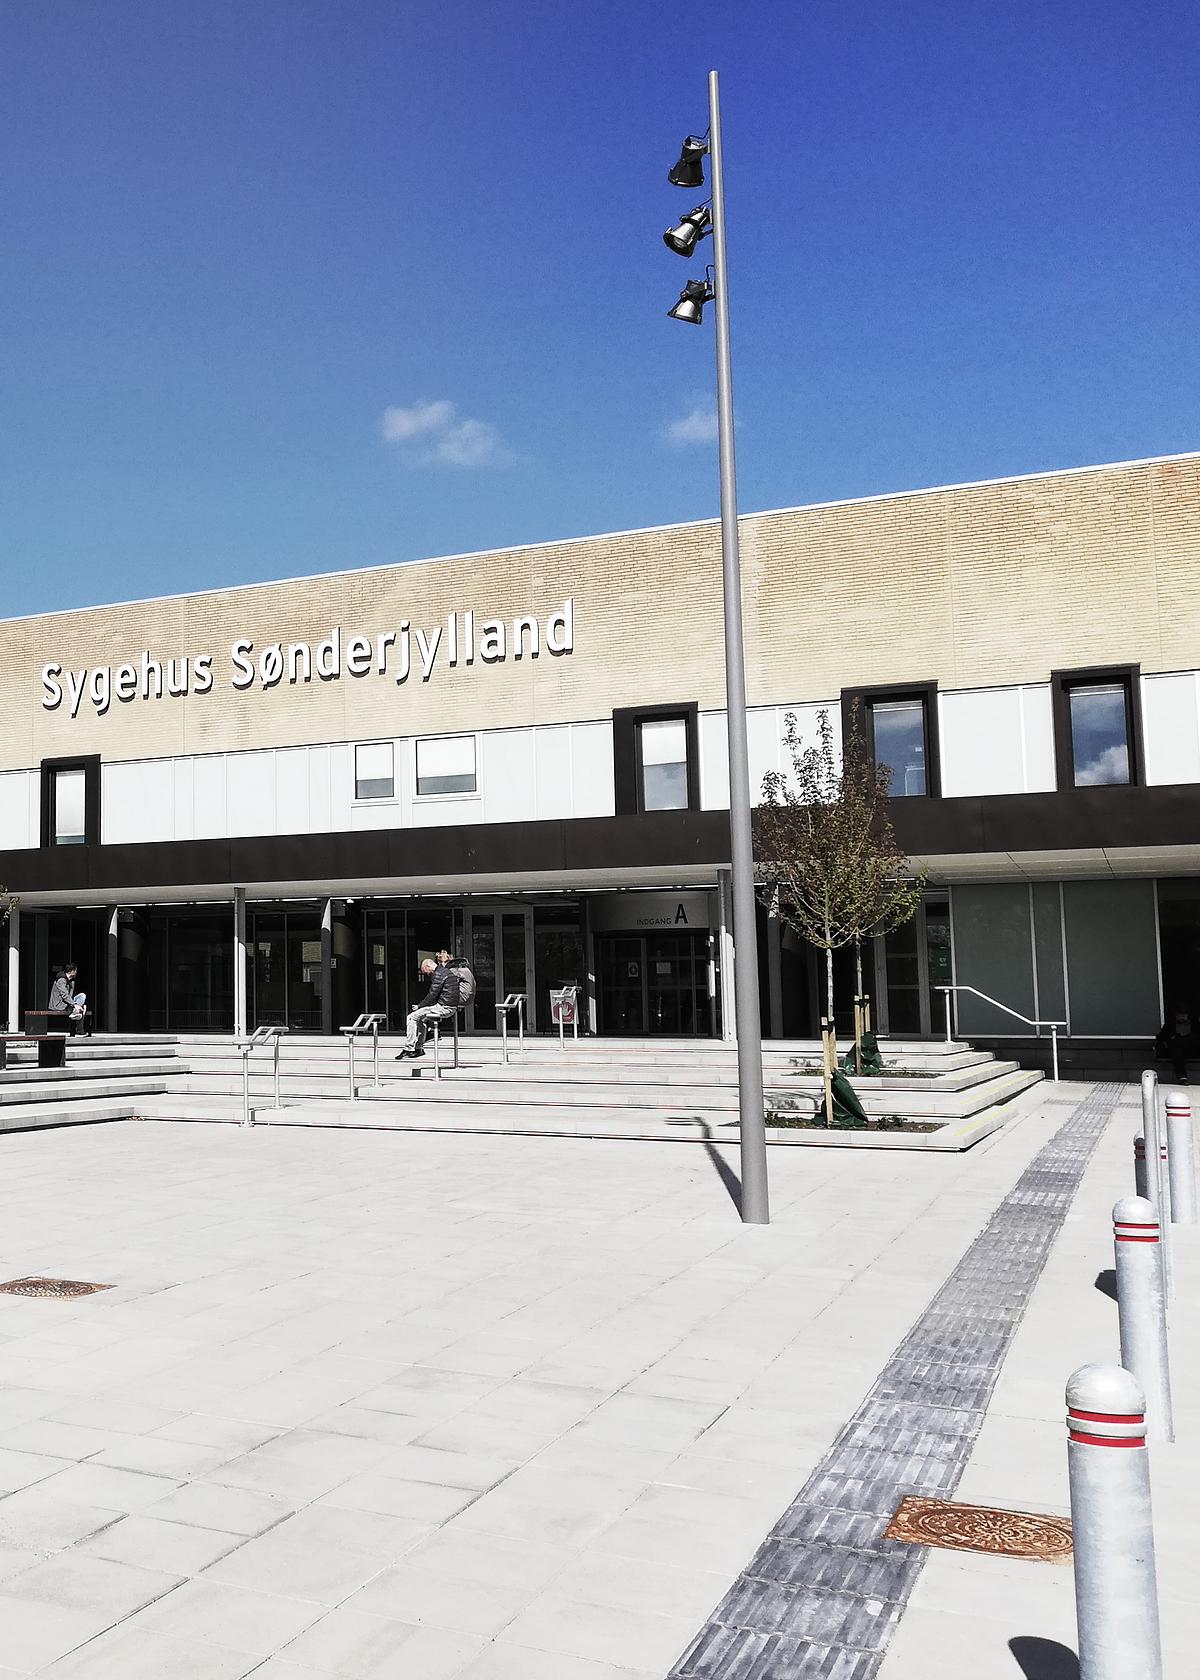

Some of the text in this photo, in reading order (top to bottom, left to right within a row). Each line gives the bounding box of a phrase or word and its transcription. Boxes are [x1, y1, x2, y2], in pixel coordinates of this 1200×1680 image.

[41, 598, 576, 718] Sygehus Sønderjylland
[636, 903, 689, 926] INDGANG A
